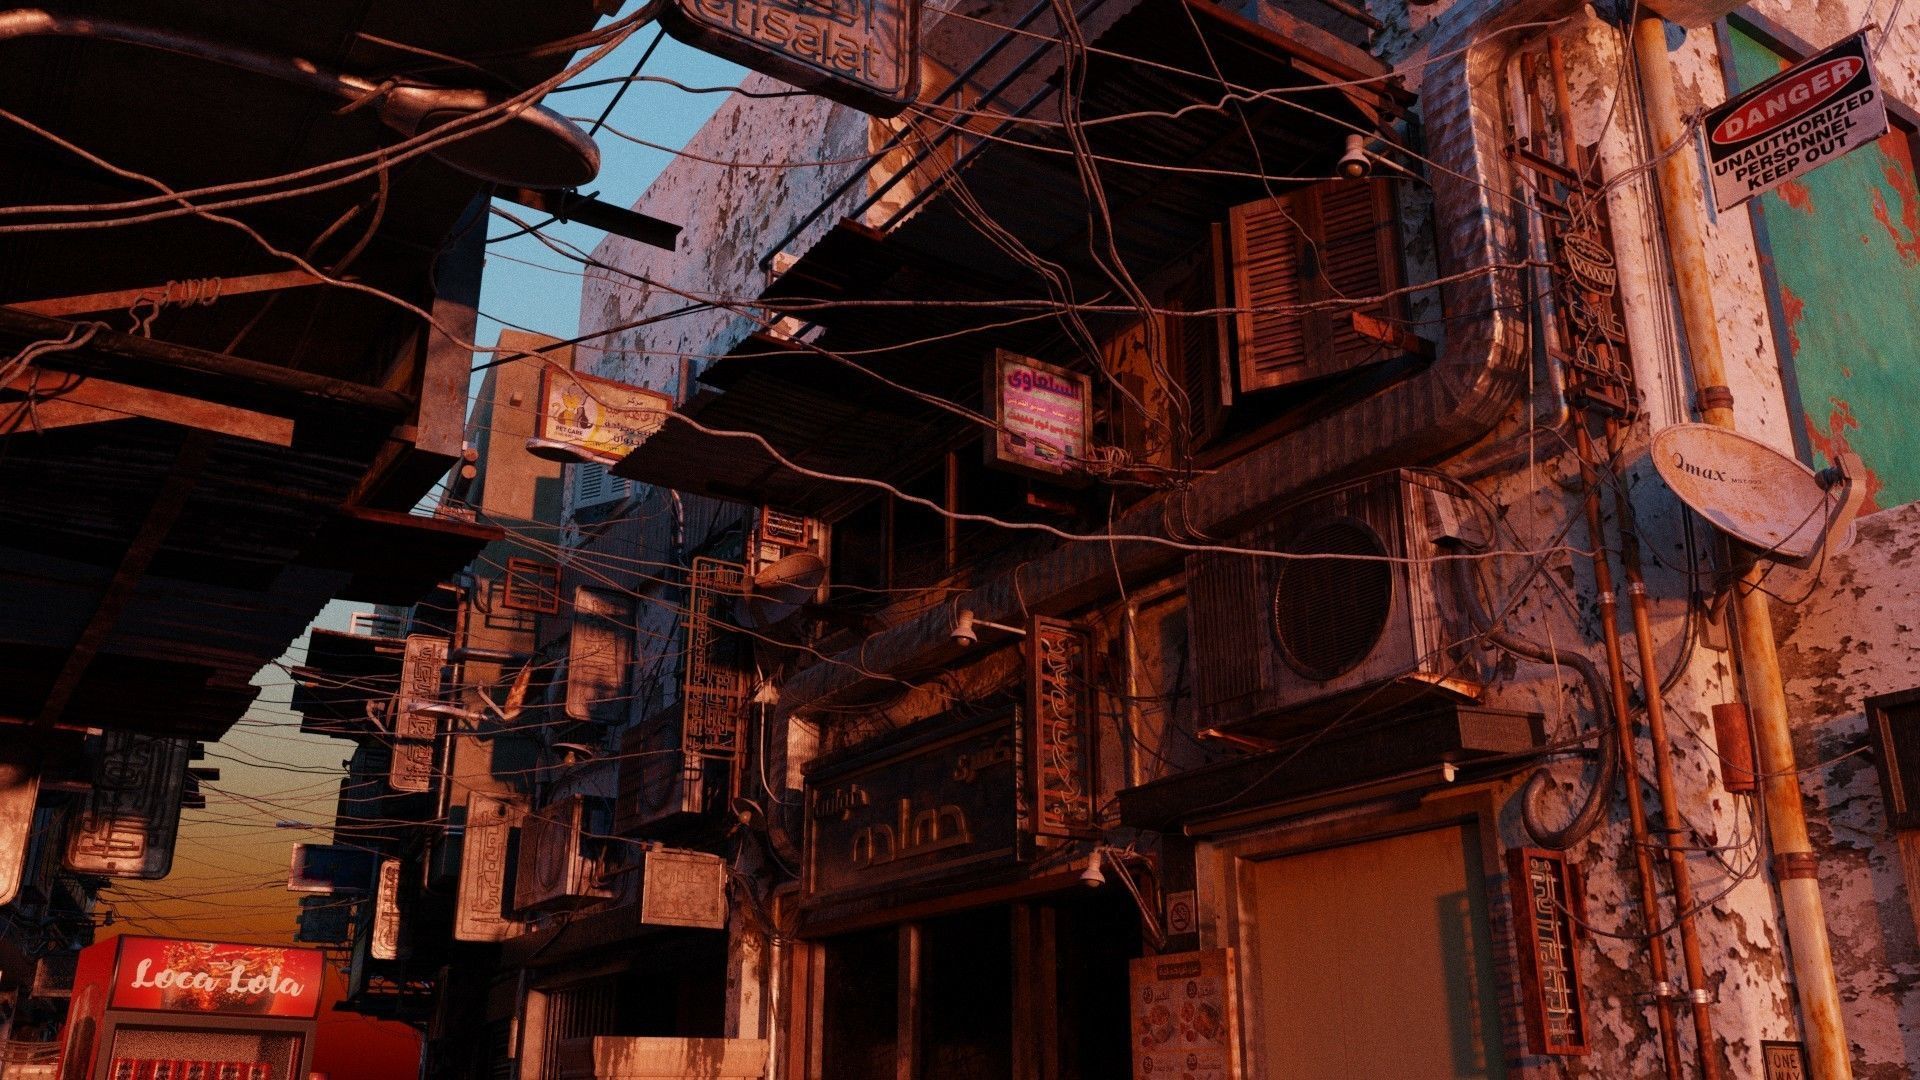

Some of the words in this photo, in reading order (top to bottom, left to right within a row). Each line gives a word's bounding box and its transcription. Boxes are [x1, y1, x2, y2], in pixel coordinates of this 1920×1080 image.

[1725, 60, 1853, 139] DANGER
[1714, 89, 1875, 177] UNAUTHORIZED
[1735, 116, 1857, 183] PERSONNEL
[1748, 156, 1800, 192] KEEP
[1805, 132, 1848, 163] OUT
[567, 428, 583, 436] CARE
[1672, 452, 1727, 483] Qmax
[131, 957, 222, 993] Loca
[226, 964, 305, 998] Lola
[1773, 1054, 1797, 1068] ONE
[1775, 1072, 1800, 1080] WAY
